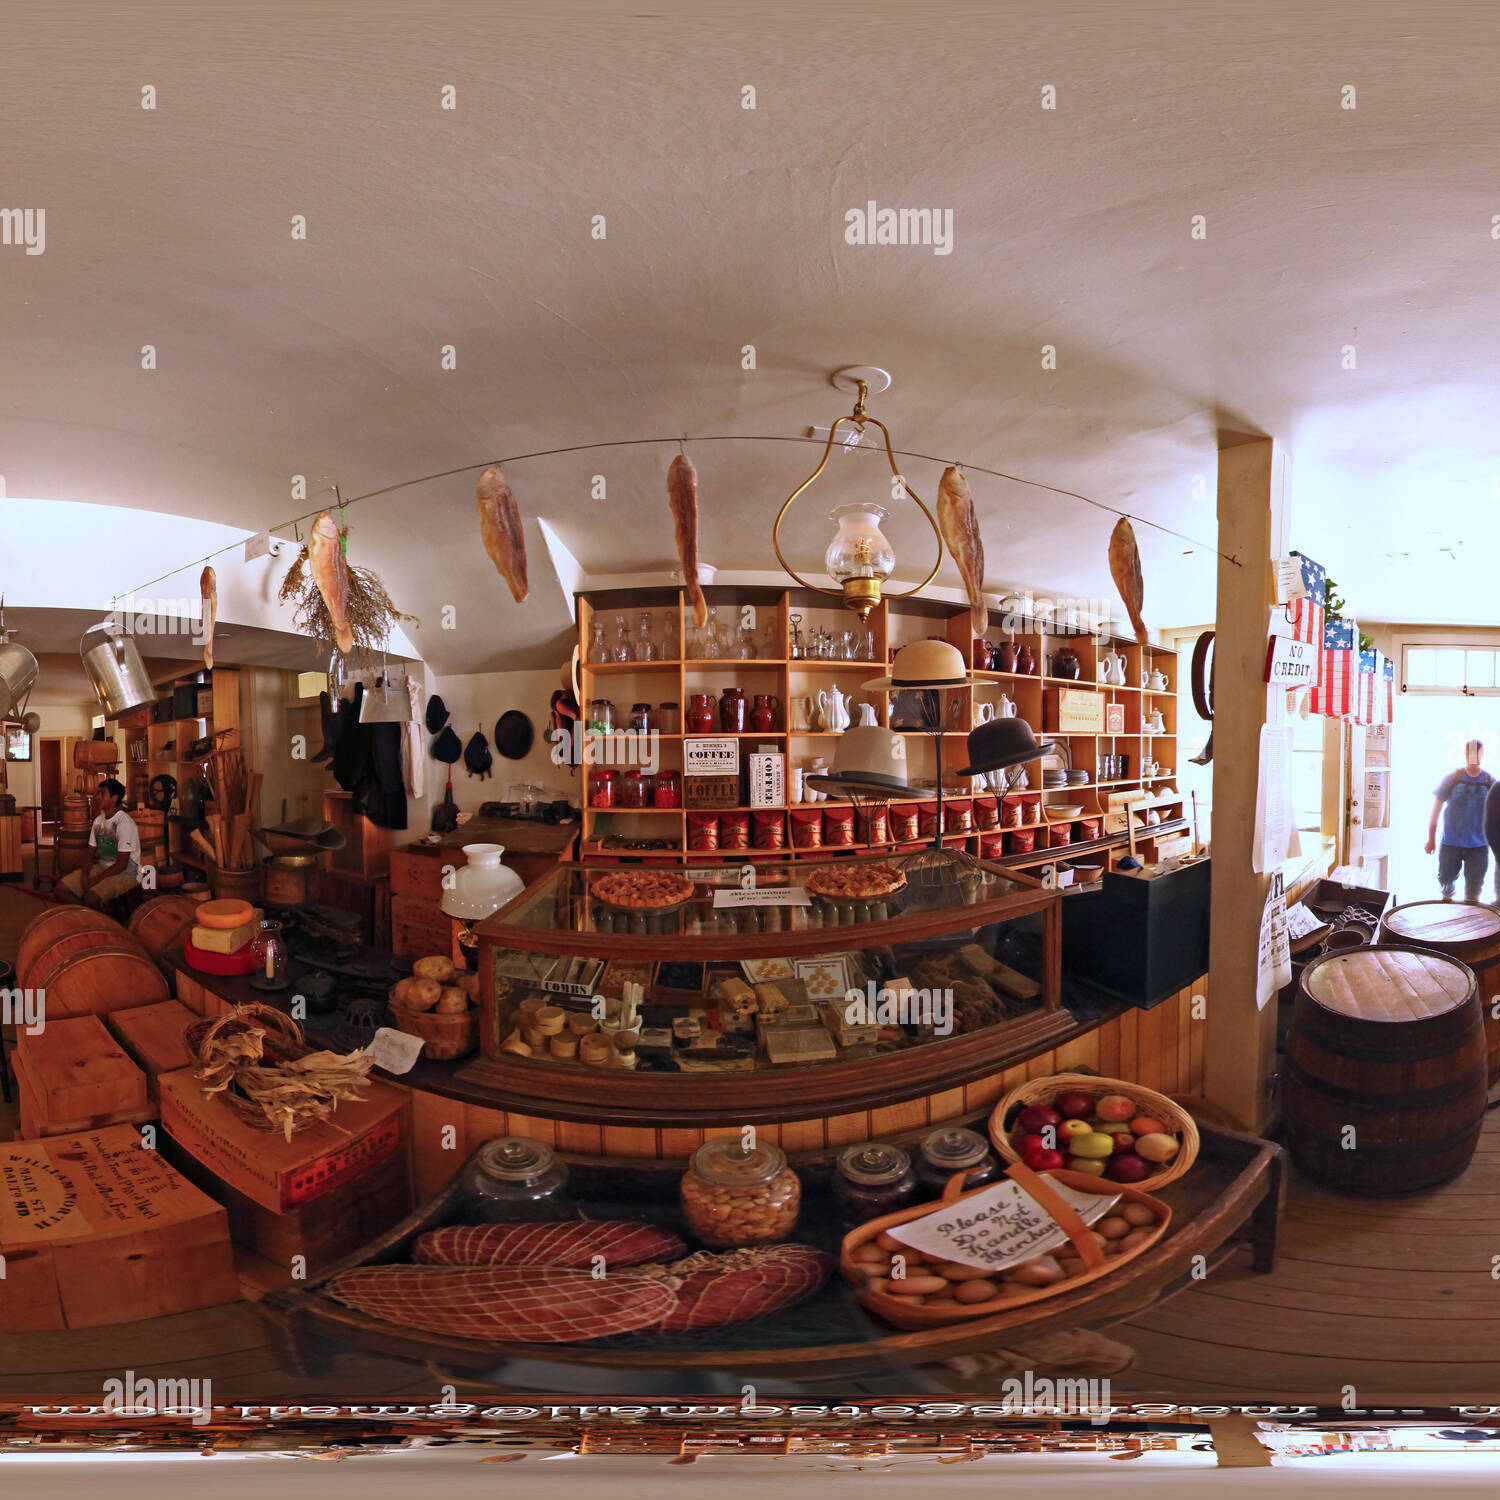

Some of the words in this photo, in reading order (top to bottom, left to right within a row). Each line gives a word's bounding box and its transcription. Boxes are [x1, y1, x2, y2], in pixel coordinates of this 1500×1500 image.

[1274, 661, 1311, 677] CREDIT
[1288, 644, 1304, 658] NO
[765, 757, 773, 804] COFFEE
[544, 982, 587, 994] COMBS
[9, 1154, 74, 1191] WILLIAM
[18, 1167, 39, 1194] MAIN
[937, 1200, 1011, 1238] Please
[952, 1229, 991, 1249] Do
[991, 1203, 1031, 1228] Not
[961, 1216, 1042, 1258] Handle
[978, 1221, 1059, 1264] Merchan
